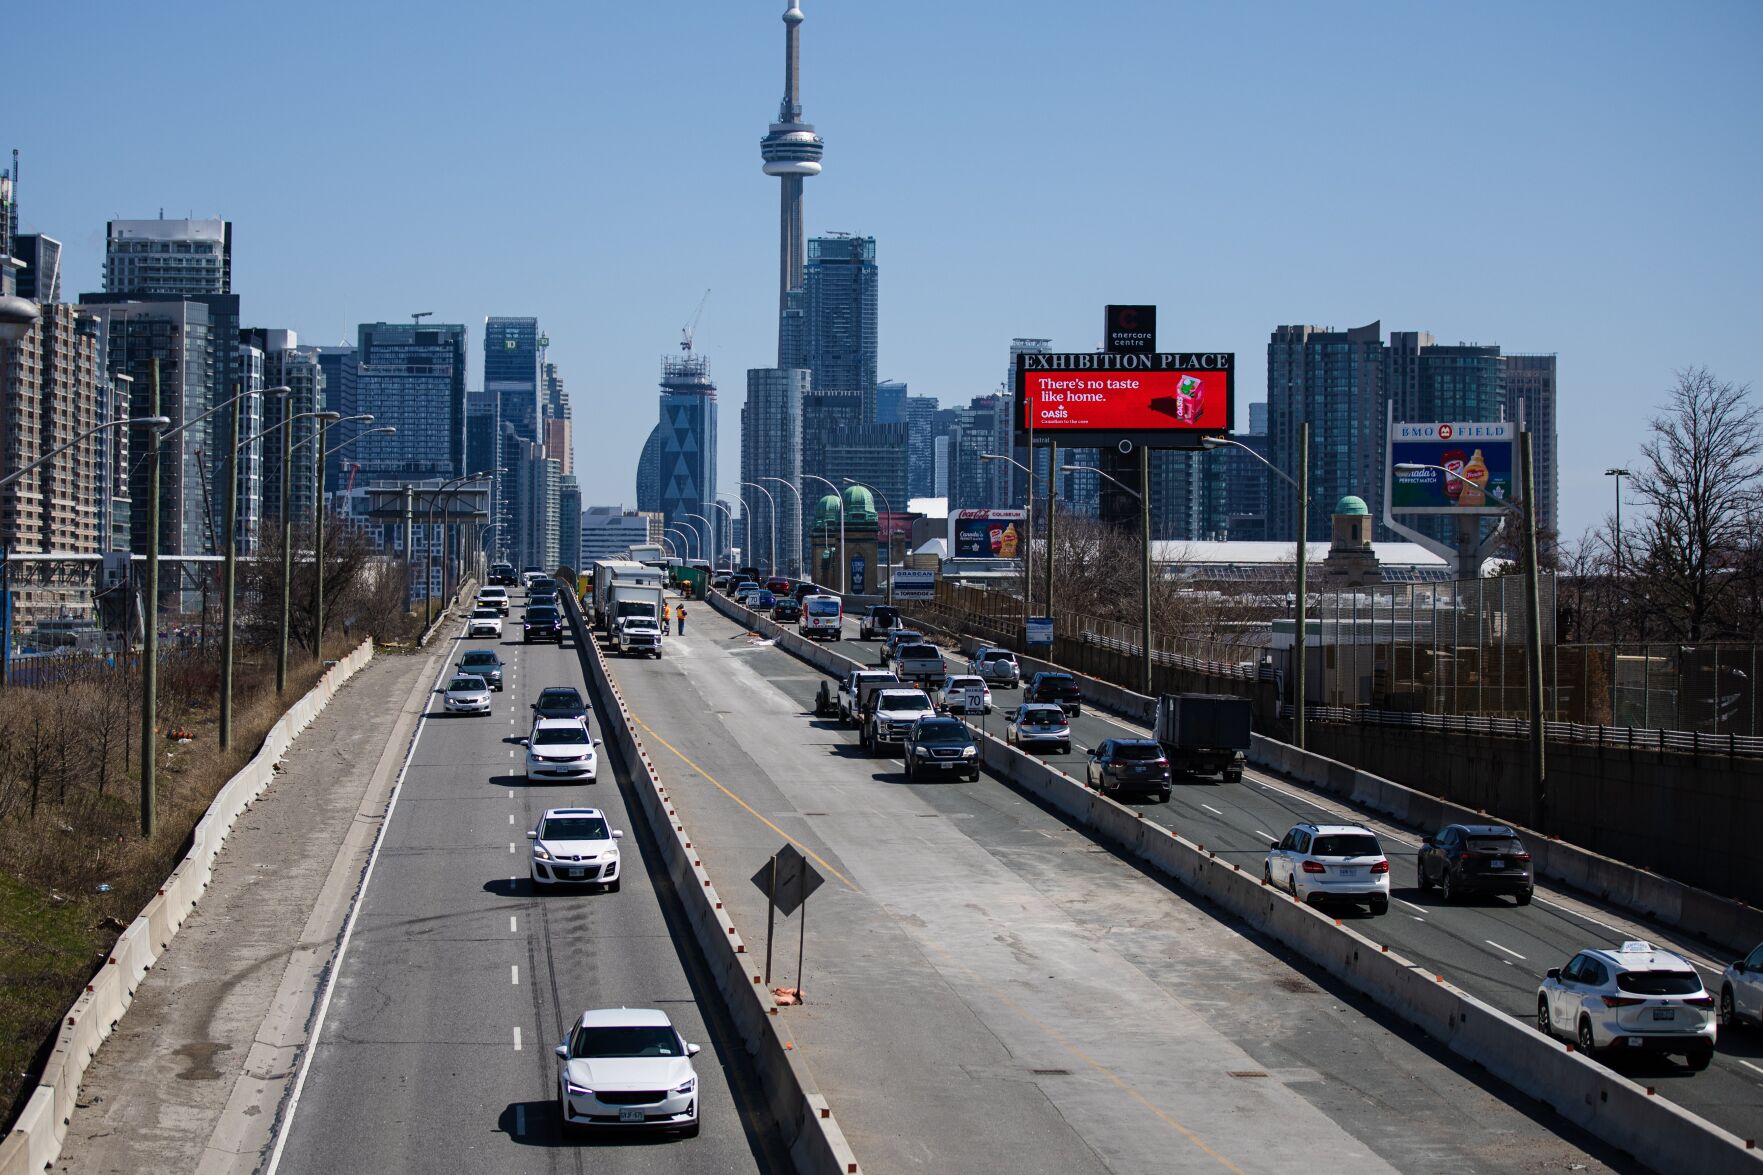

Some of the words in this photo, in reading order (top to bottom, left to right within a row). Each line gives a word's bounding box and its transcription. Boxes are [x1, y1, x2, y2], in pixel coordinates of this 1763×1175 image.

[1023, 354, 1153, 369] EXHIBITION
[1160, 353, 1229, 369] PLACE
[1038, 378, 1085, 389] There's
[1087, 381, 1104, 389] no
[1107, 379, 1140, 389] taste
[1041, 391, 1064, 402] like
[1067, 391, 1107, 402] home.
[1041, 410, 1068, 418] OASIS
[1402, 427, 1434, 437] BMO
[1458, 427, 1504, 436] FIELD
[967, 695, 981, 706] 70
